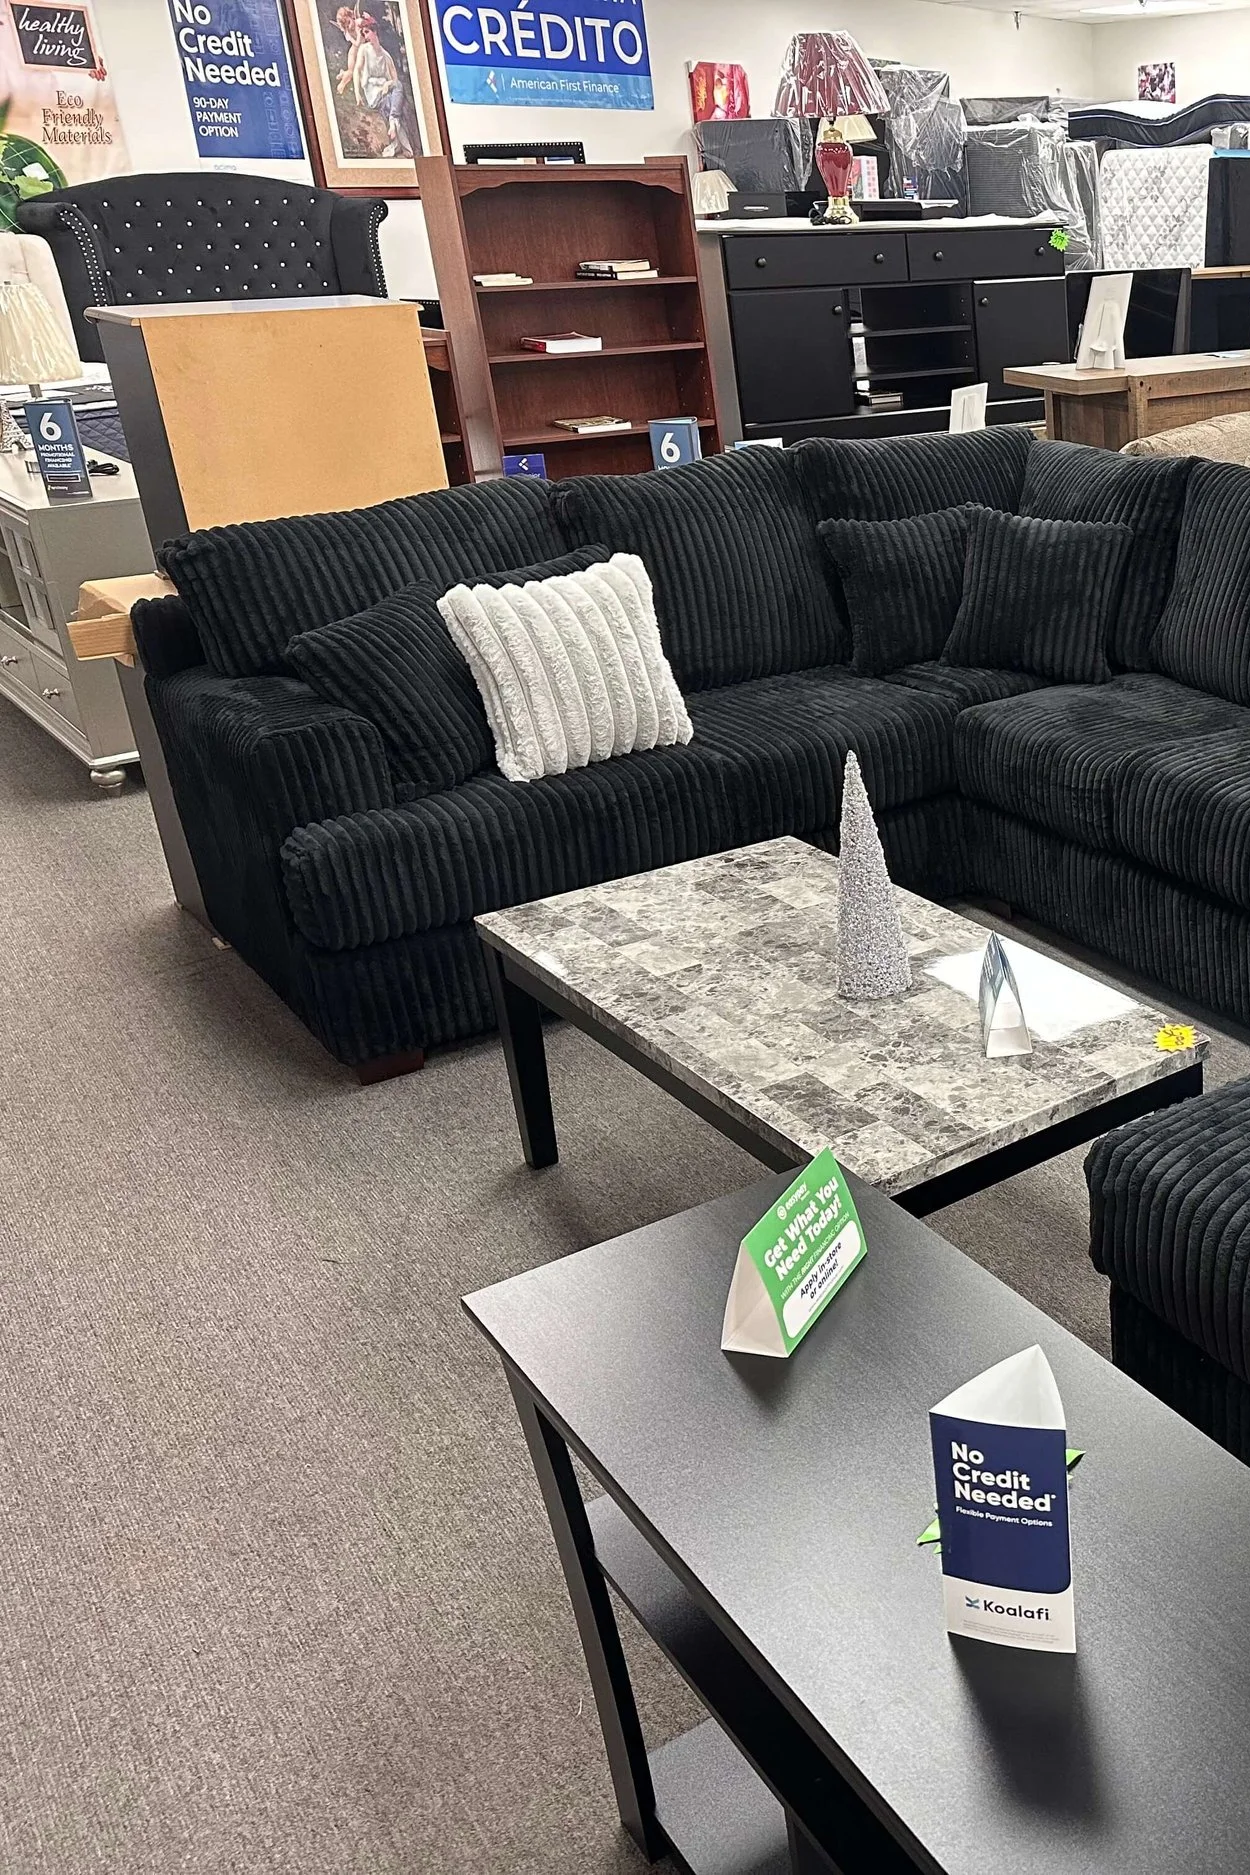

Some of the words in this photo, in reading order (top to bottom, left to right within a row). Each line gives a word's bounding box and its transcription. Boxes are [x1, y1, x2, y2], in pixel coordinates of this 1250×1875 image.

[173, 0, 211, 25] No
[18, 7, 85, 47] healthy
[442, 0, 643, 65] CRÉDITO
[33, 34, 88, 66] living
[179, 27, 255, 58] Credit
[183, 56, 281, 87] Needed
[56, 90, 84, 107] Eco
[510, 77, 557, 91] American
[560, 79, 582, 92] First
[583, 80, 619, 94] Finance
[193, 96, 229, 109] 90-DAY
[42, 108, 104, 129] Friendly
[195, 111, 242, 124] PAYMENT
[42, 126, 113, 144] Materials
[199, 125, 239, 138] OPTION
[40, 412, 62, 441] 6
[38, 444, 74, 452] MONTHS
[661, 432, 681, 463] 6
[764, 1236, 789, 1268] Get
[784, 1199, 819, 1242] What
[815, 1176, 839, 1205] You
[775, 1235, 808, 1281] Need
[804, 1193, 842, 1243] Today!
[800, 1271, 818, 1299] Apply
[818, 1241, 842, 1274] in-store
[809, 1288, 818, 1300] or
[817, 1258, 839, 1288] online!
[951, 1441, 985, 1465] No
[952, 1462, 1031, 1491] Credit
[955, 1505, 984, 1518] Flexible
[985, 1512, 1020, 1524] Payment
[1020, 1517, 1053, 1527] Options
[983, 1600, 1050, 1621] Koalafi
